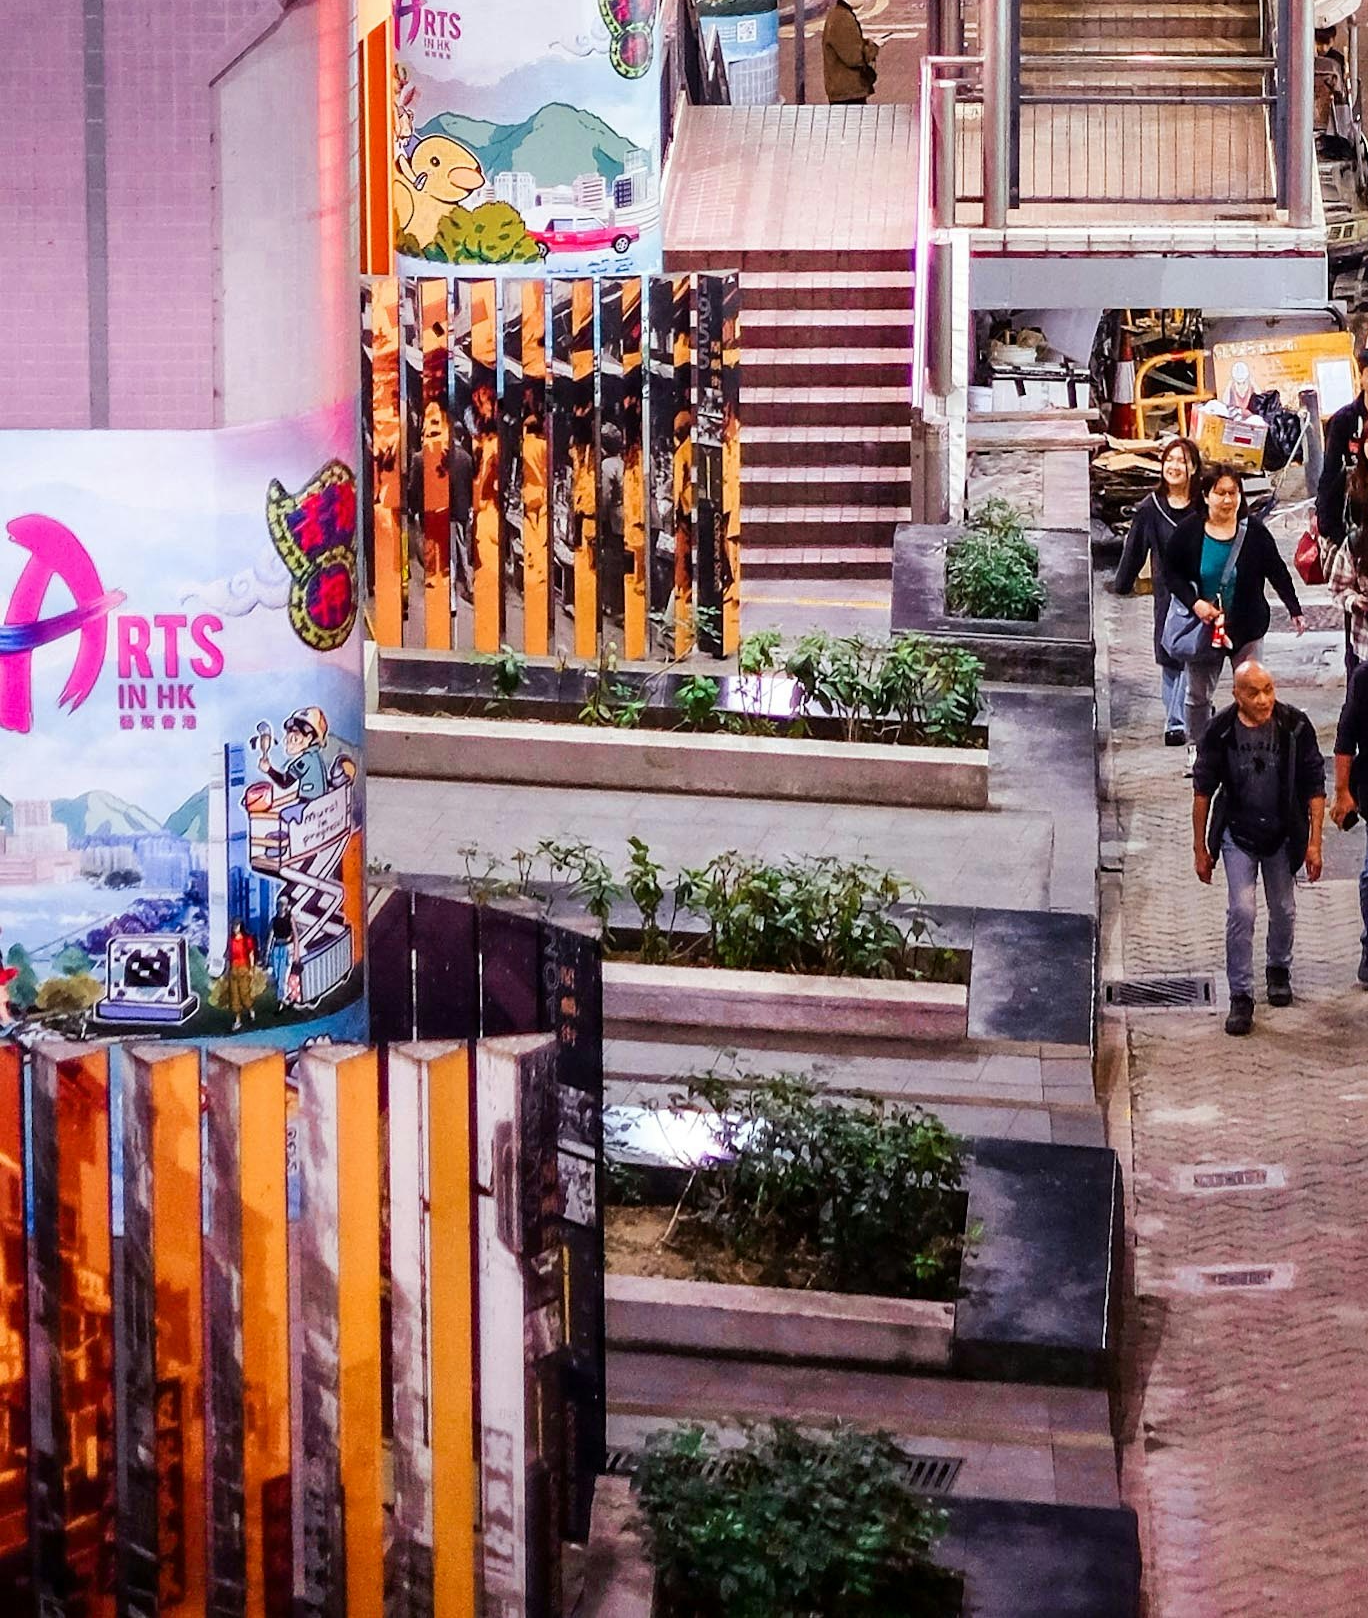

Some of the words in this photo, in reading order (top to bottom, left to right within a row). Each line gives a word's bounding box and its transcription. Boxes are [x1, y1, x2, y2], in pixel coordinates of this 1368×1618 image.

[424, 37, 434, 49] IN
[437, 39, 451, 51] HK
[0, 513, 226, 735] ARTS
[118, 683, 147, 709] IN
[157, 683, 197, 709] HK
